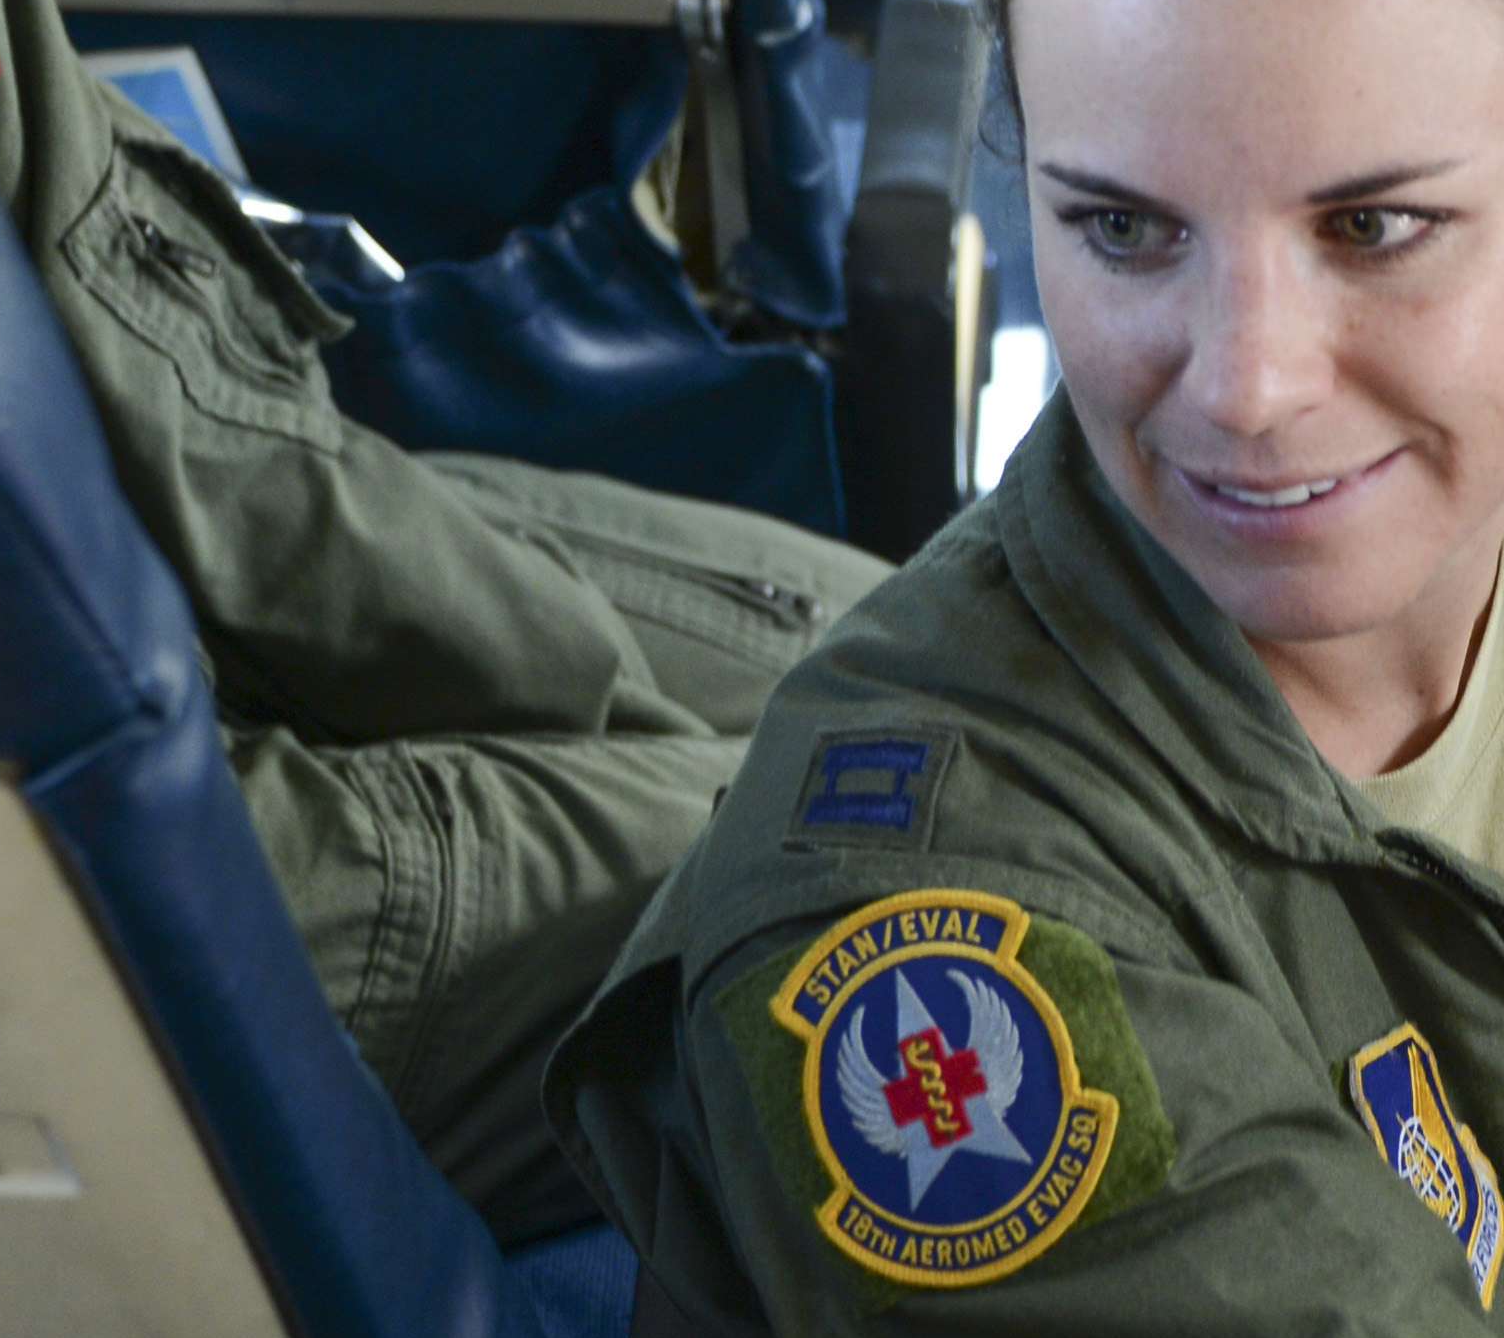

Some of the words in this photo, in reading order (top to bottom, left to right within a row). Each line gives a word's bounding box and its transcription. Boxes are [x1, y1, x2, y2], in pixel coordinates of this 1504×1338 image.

[804, 908, 982, 1006] STAN/EVAL
[843, 1204, 898, 1257] 18TH
[899, 1194, 1029, 1268] AEROMED
[1026, 1156, 1084, 1227] EVAC
[1068, 1112, 1099, 1153] SQ
